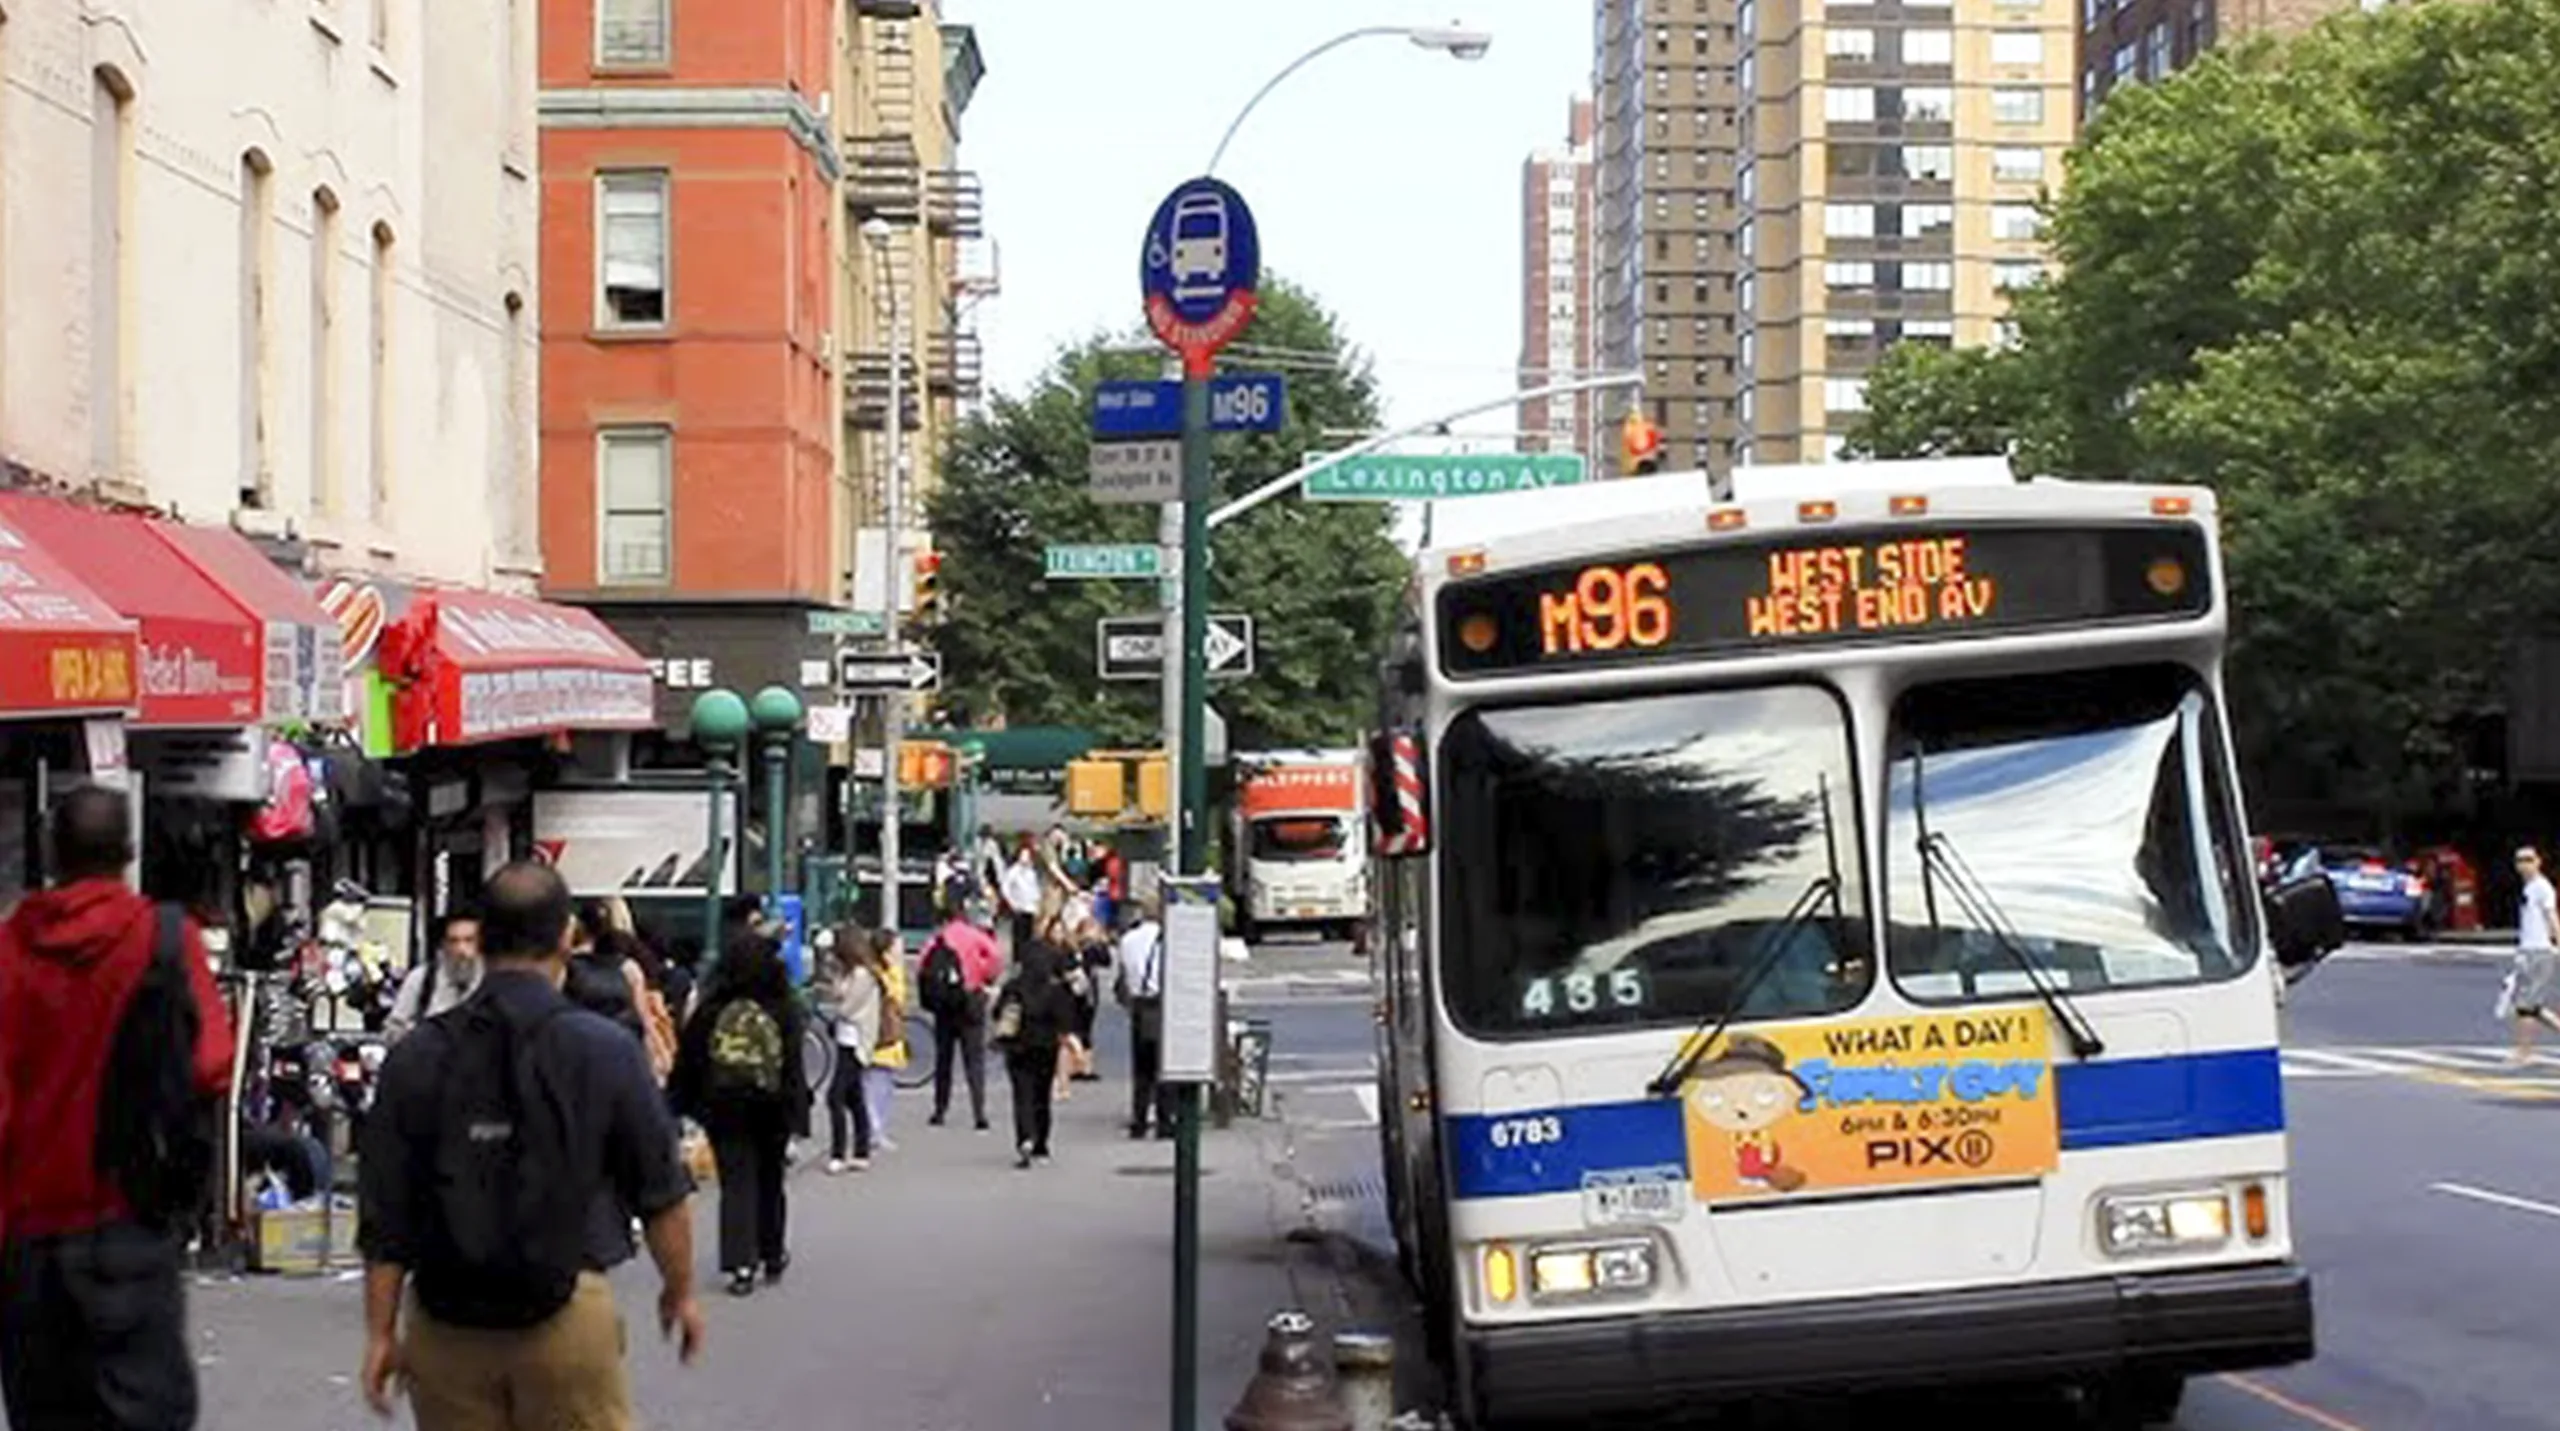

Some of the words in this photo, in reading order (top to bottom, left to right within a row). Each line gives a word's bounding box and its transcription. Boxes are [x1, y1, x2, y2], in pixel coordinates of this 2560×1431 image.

[1212, 383, 1270, 423] M96
[1330, 465, 1506, 493] Lexington
[1515, 467, 1558, 489] Av
[1768, 547, 1863, 596] WEST
[1877, 539, 1966, 588] SIDE
[1539, 563, 1672, 654] M96
[1747, 591, 1841, 637] WEST
[1856, 583, 1926, 630] END
[1941, 580, 1993, 619] AV
[1522, 968, 1642, 1018] 435
[1823, 1023, 1914, 1057] WHAT
[1922, 1023, 1945, 1050] A
[1490, 1116, 1562, 1148] 6783
[1891, 1110, 1908, 1133] &
